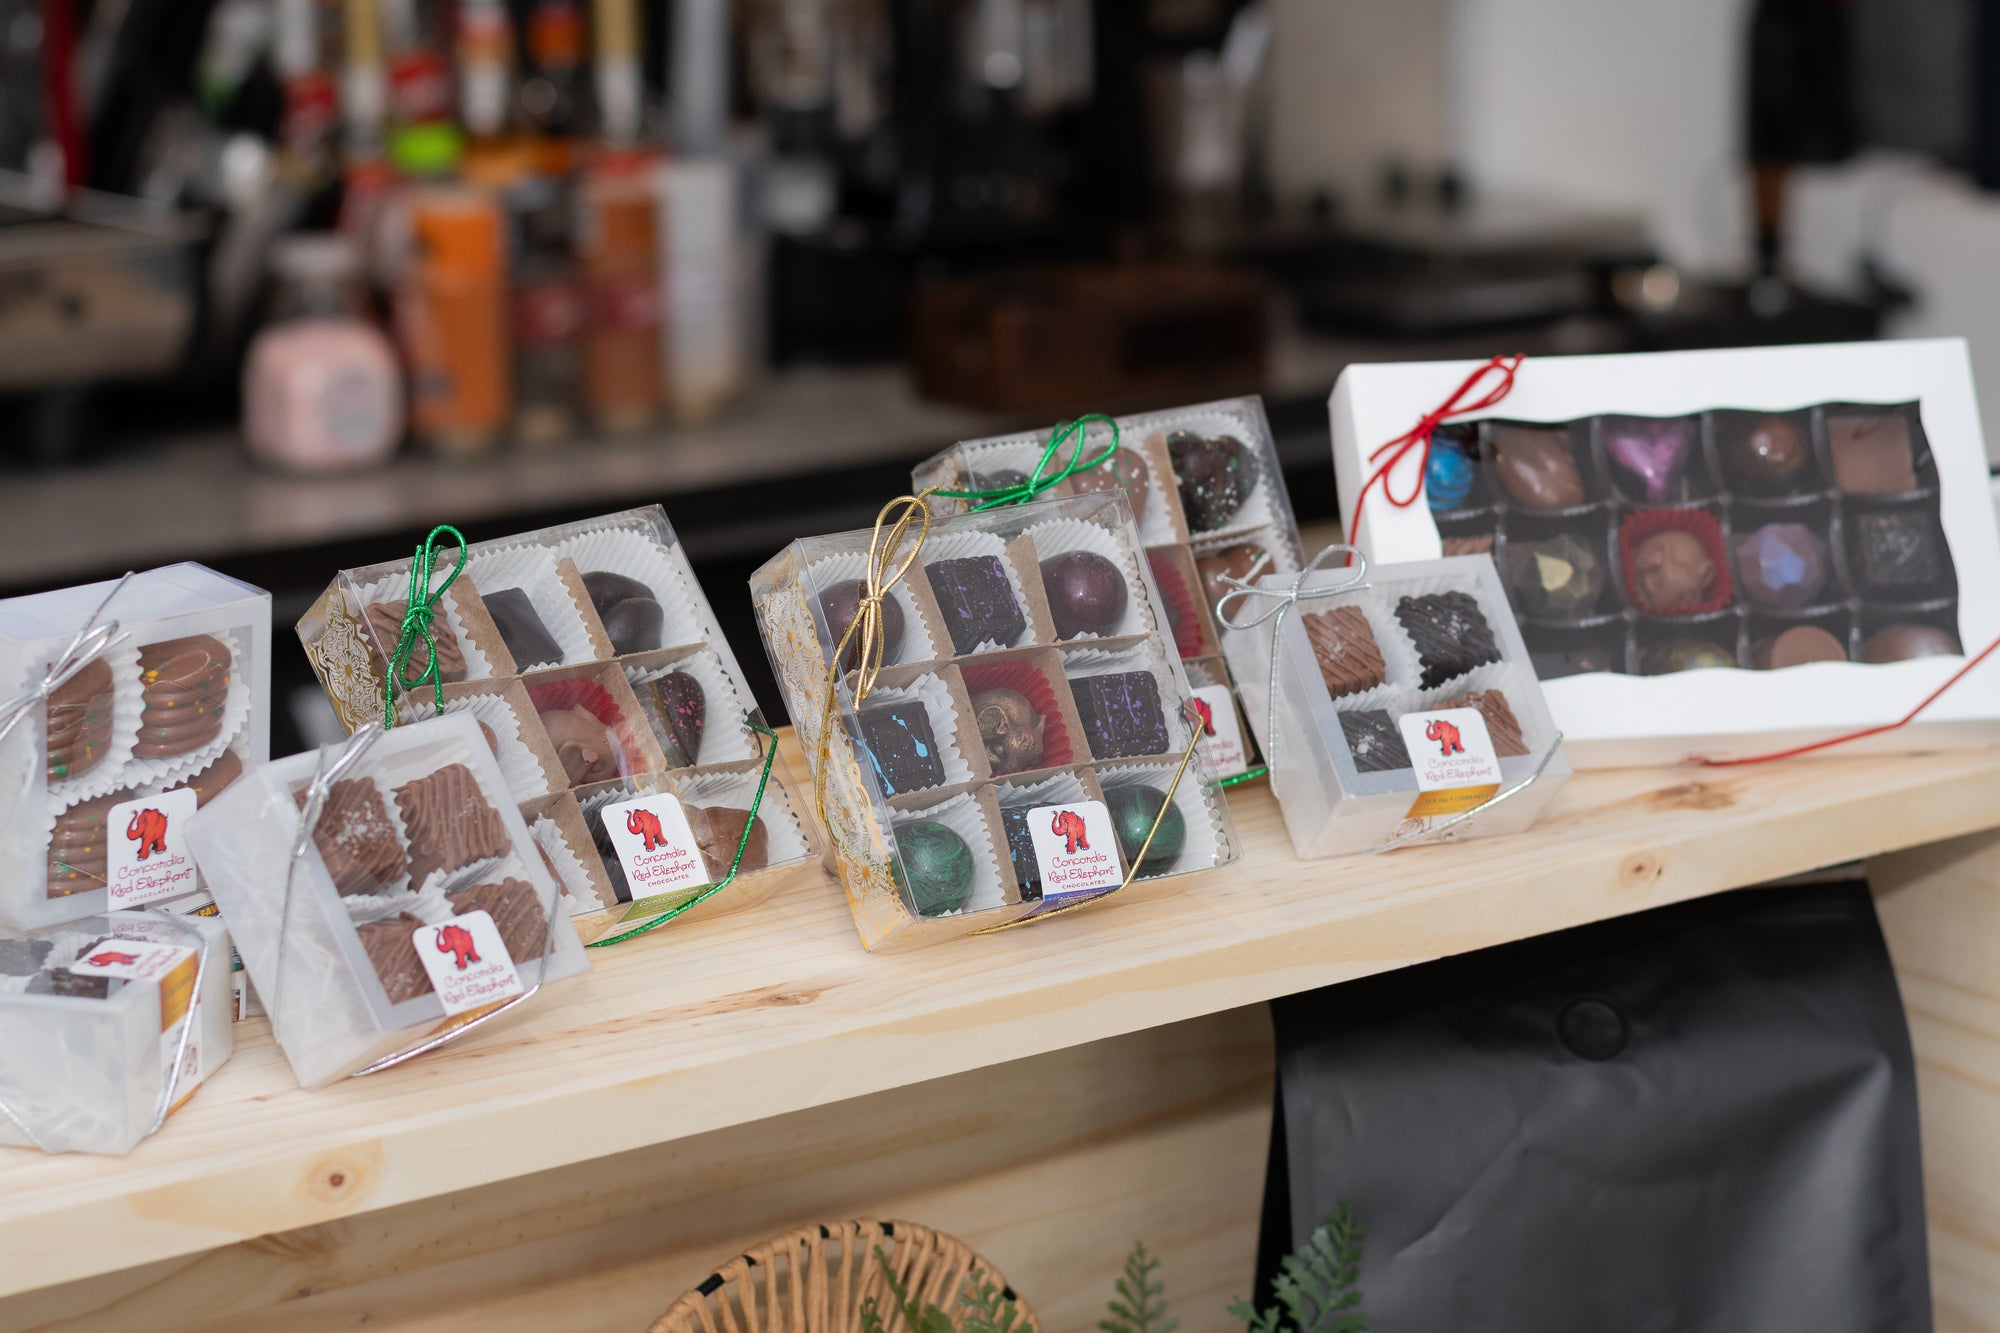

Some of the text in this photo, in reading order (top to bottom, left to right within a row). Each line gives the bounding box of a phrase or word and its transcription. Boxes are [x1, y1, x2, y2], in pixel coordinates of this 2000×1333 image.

[1428, 755, 1485, 769] Concordia
[1425, 766, 1493, 782] Red Elephant
[634, 846, 687, 866] Concordia
[1052, 850, 1107, 868] Concordia
[118, 853, 185, 879] Concordia
[632, 859, 697, 881] Red Elephant
[1047, 865, 1115, 883] Red Elephant
[110, 867, 193, 898] Red Elephant
[647, 873, 690, 887] CHOCOLATES
[1061, 879, 1106, 890] CHOCOLATES
[129, 886, 176, 902] CHOCOLATES
[444, 961, 504, 988] Concordia
[443, 974, 516, 1004] Red Elephant
